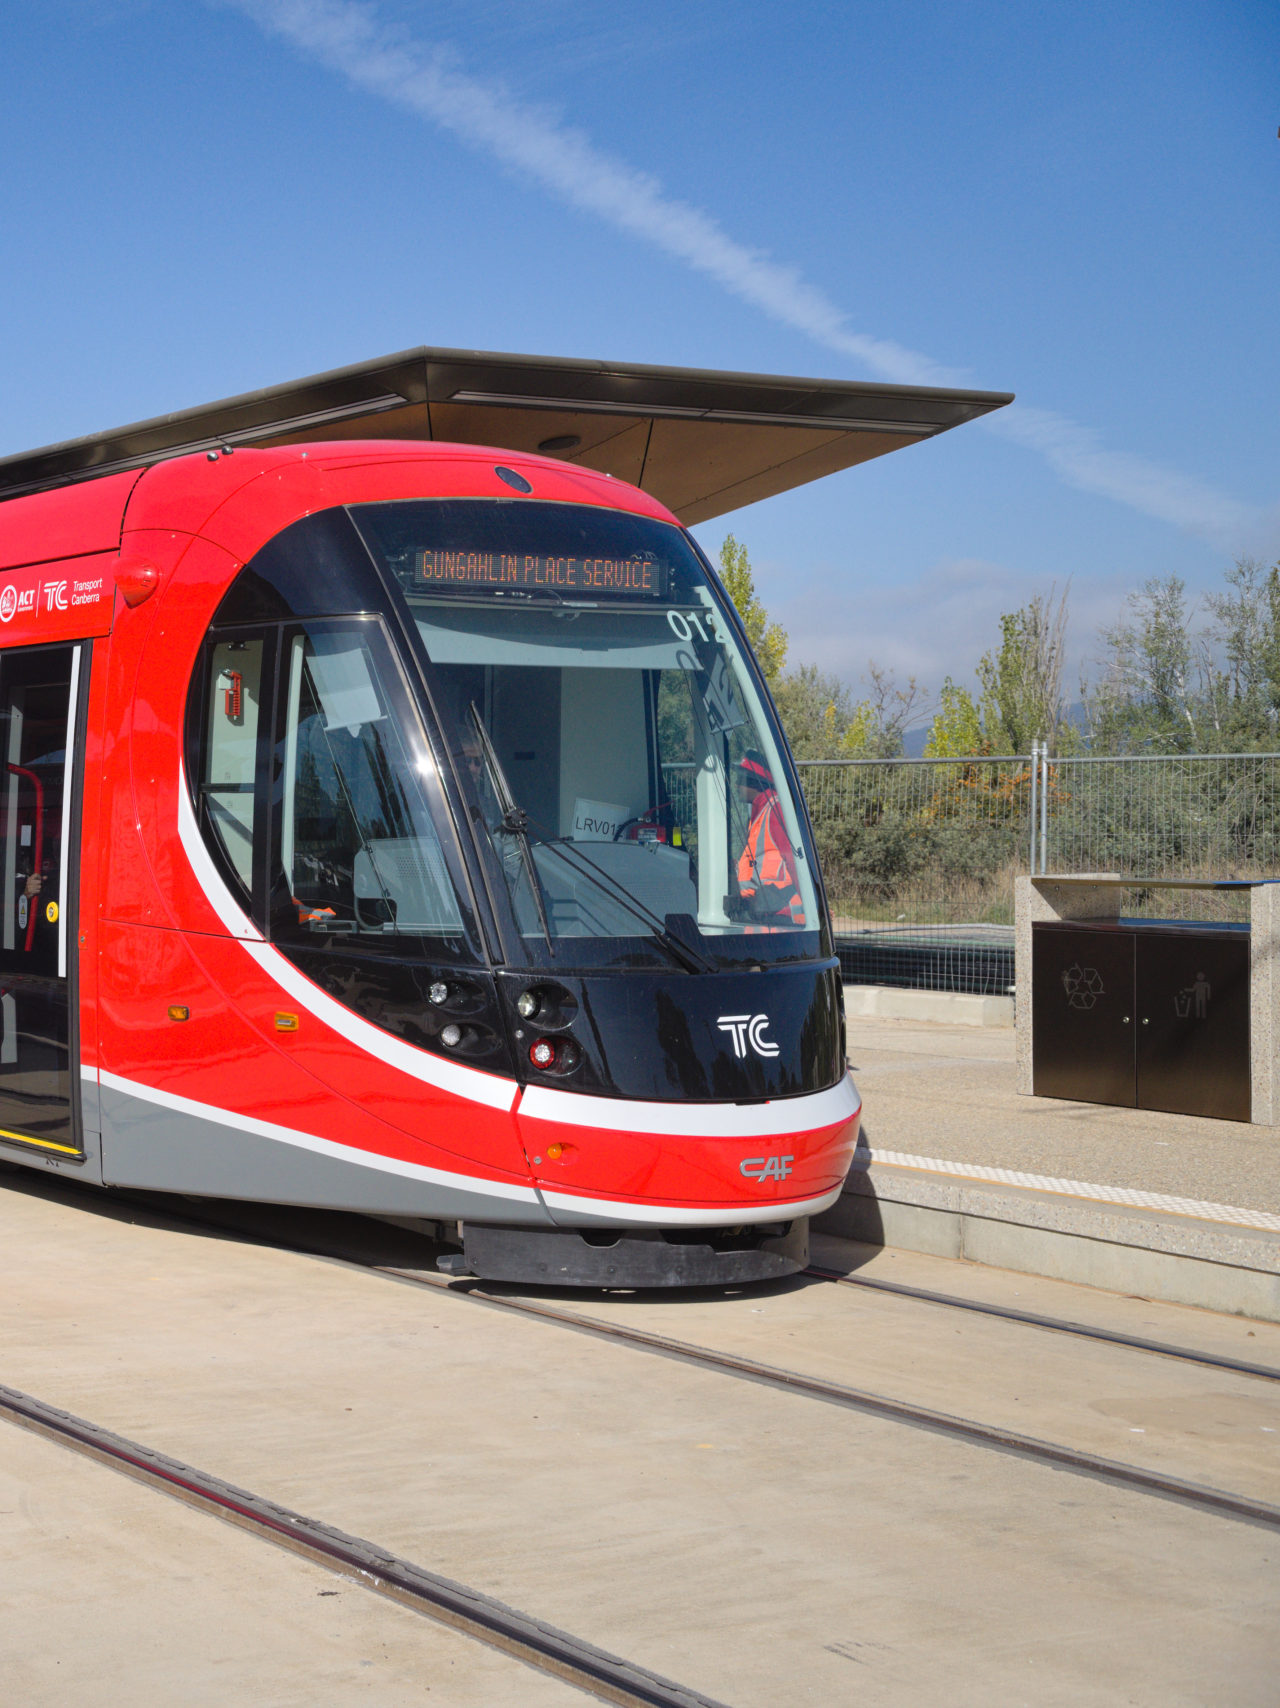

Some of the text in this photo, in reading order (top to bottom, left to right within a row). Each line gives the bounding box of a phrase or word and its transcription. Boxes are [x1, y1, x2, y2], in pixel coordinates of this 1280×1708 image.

[423, 550, 652, 588] GUNGAHLIN PLACE SERVICE
[18, 589, 35, 606] ACT
[43, 580, 68, 611] TC
[71, 593, 100, 606] Canberra
[73, 578, 103, 592] Transport
[666, 609, 730, 644] 012
[716, 1013, 781, 1059] TC
[739, 1154, 795, 1183] CAF
